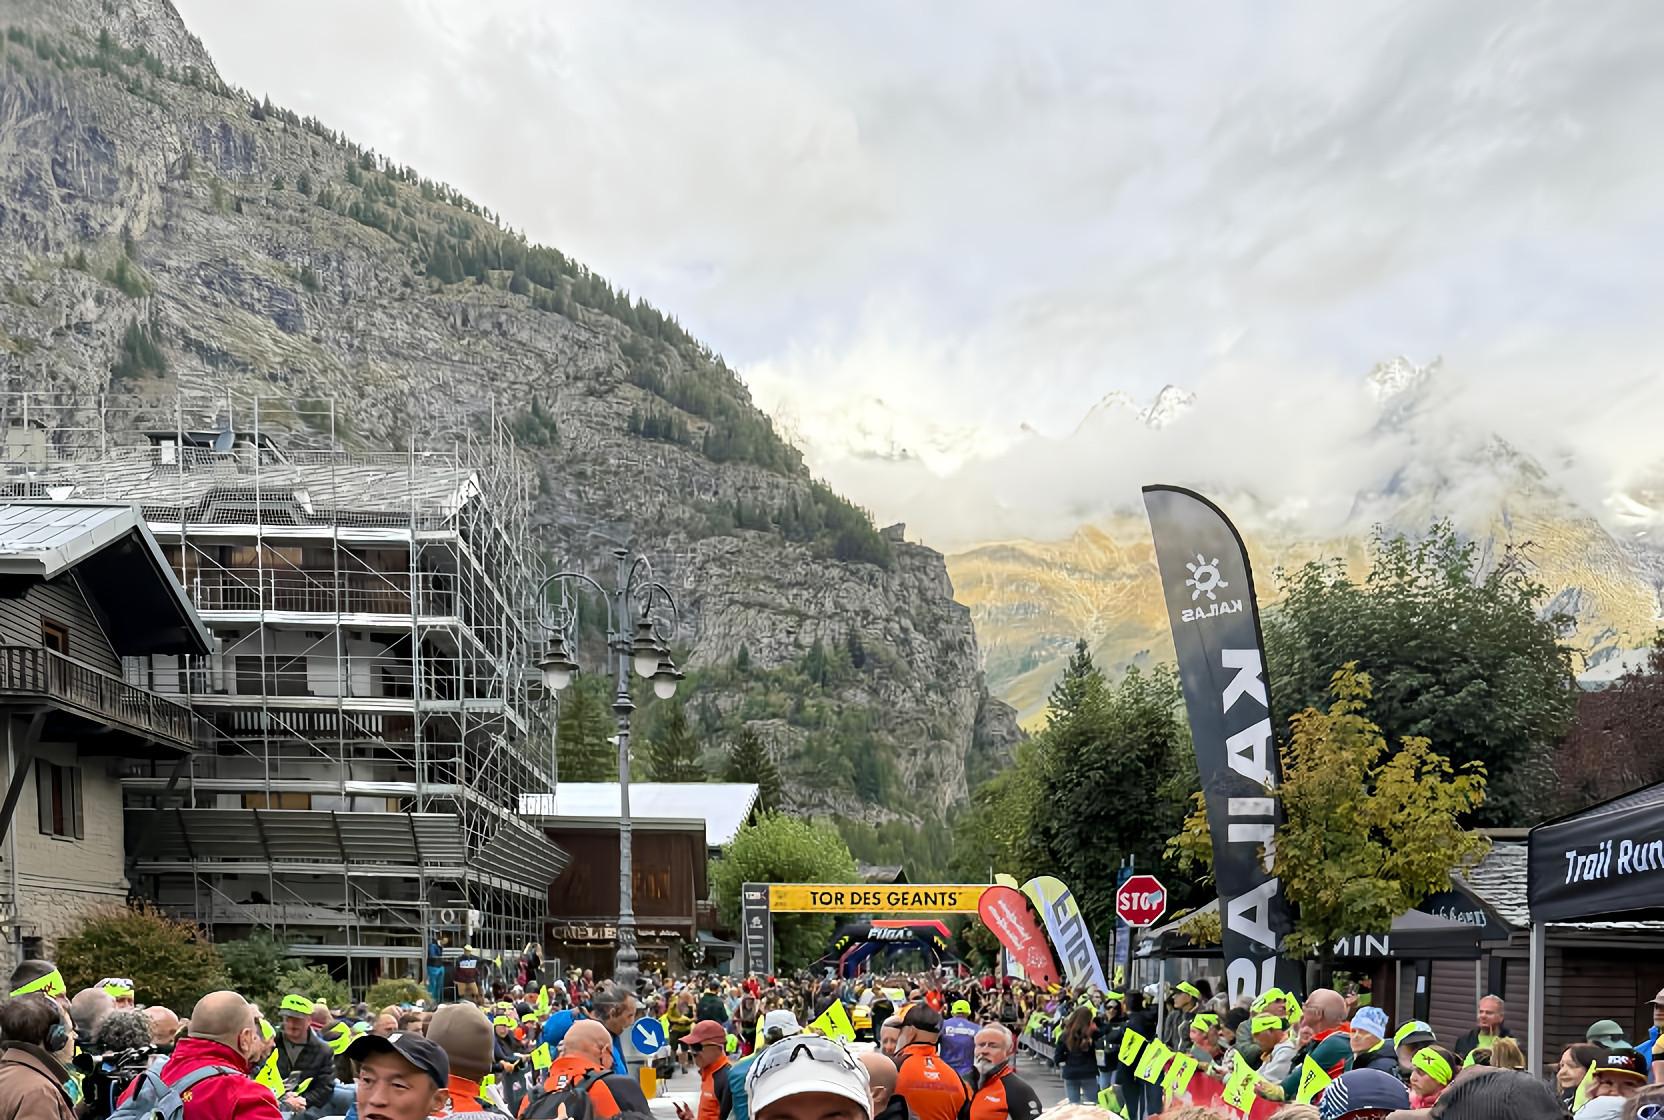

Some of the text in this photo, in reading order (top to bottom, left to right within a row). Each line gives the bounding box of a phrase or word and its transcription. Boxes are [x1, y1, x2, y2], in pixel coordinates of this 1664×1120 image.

[1565, 840, 1613, 885] Trail
[810, 892, 957, 906] TOR DES GEANTS
